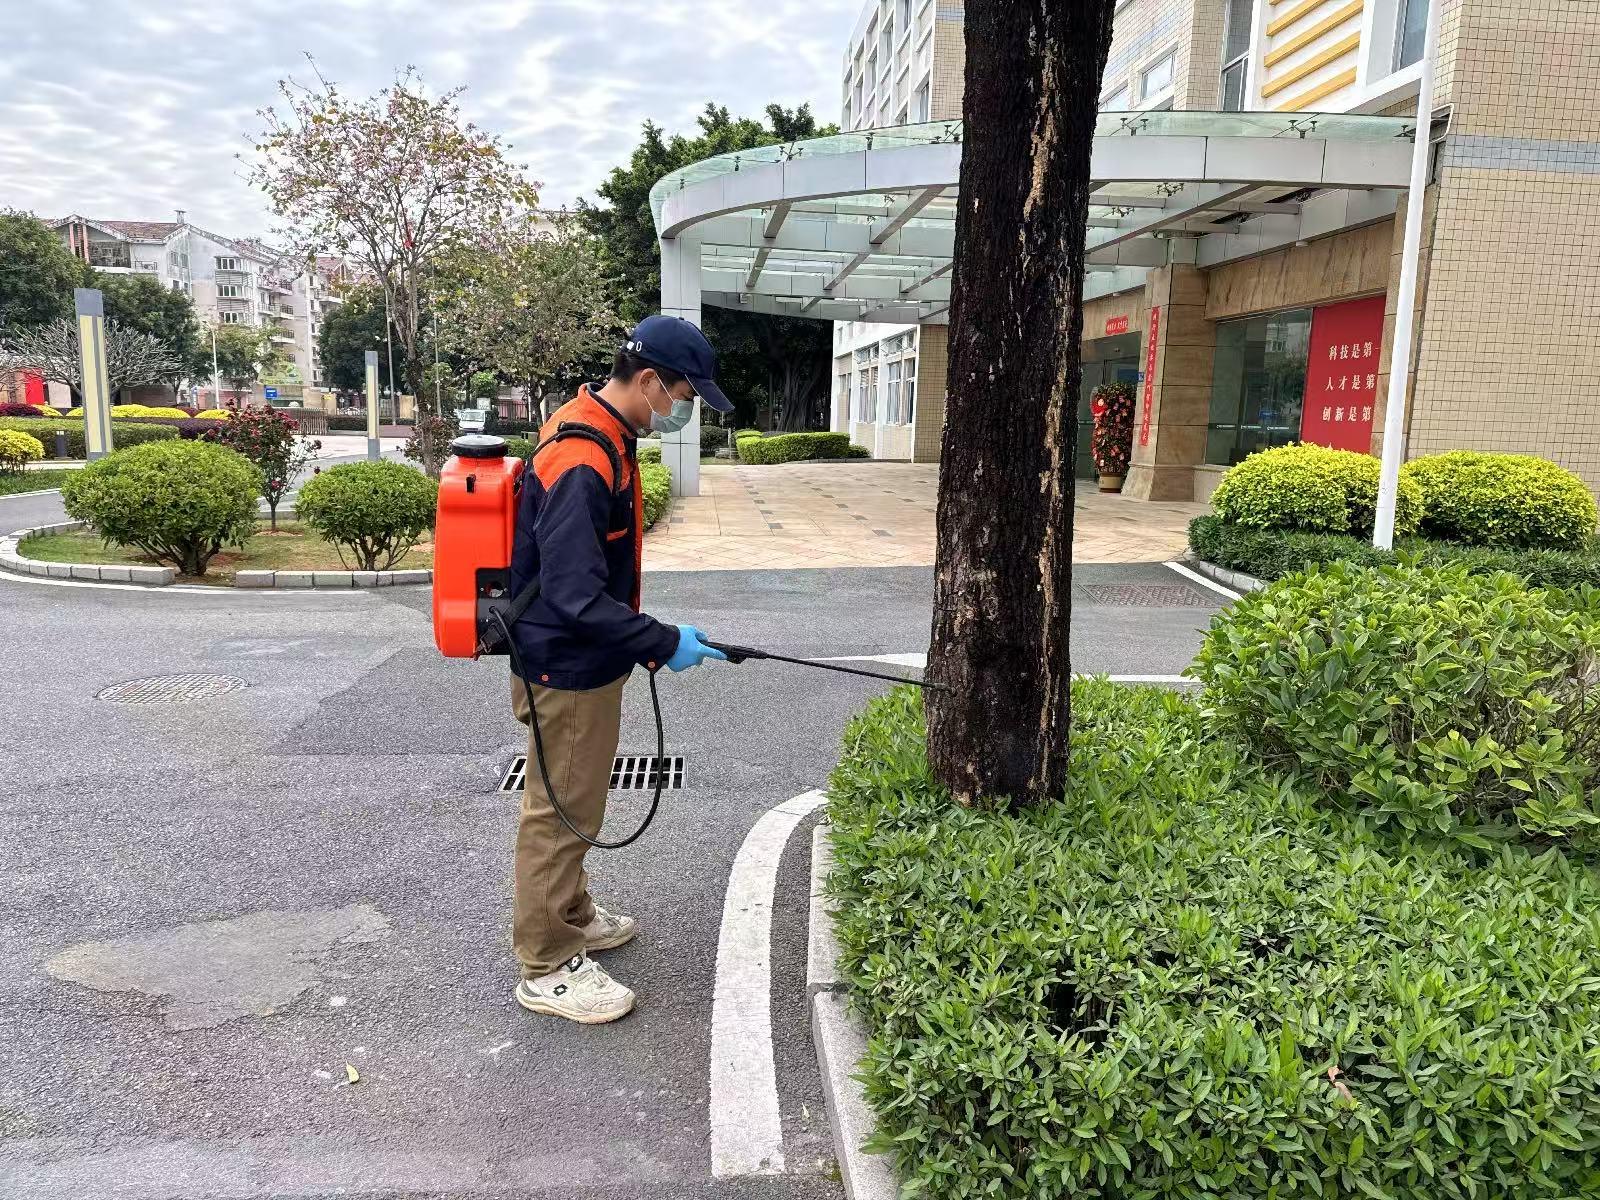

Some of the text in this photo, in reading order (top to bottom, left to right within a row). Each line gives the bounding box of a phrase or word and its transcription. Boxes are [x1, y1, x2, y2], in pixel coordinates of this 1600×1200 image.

[1325, 374, 1376, 391] 人才是第
[1322, 406, 1372, 422] 创新是第
